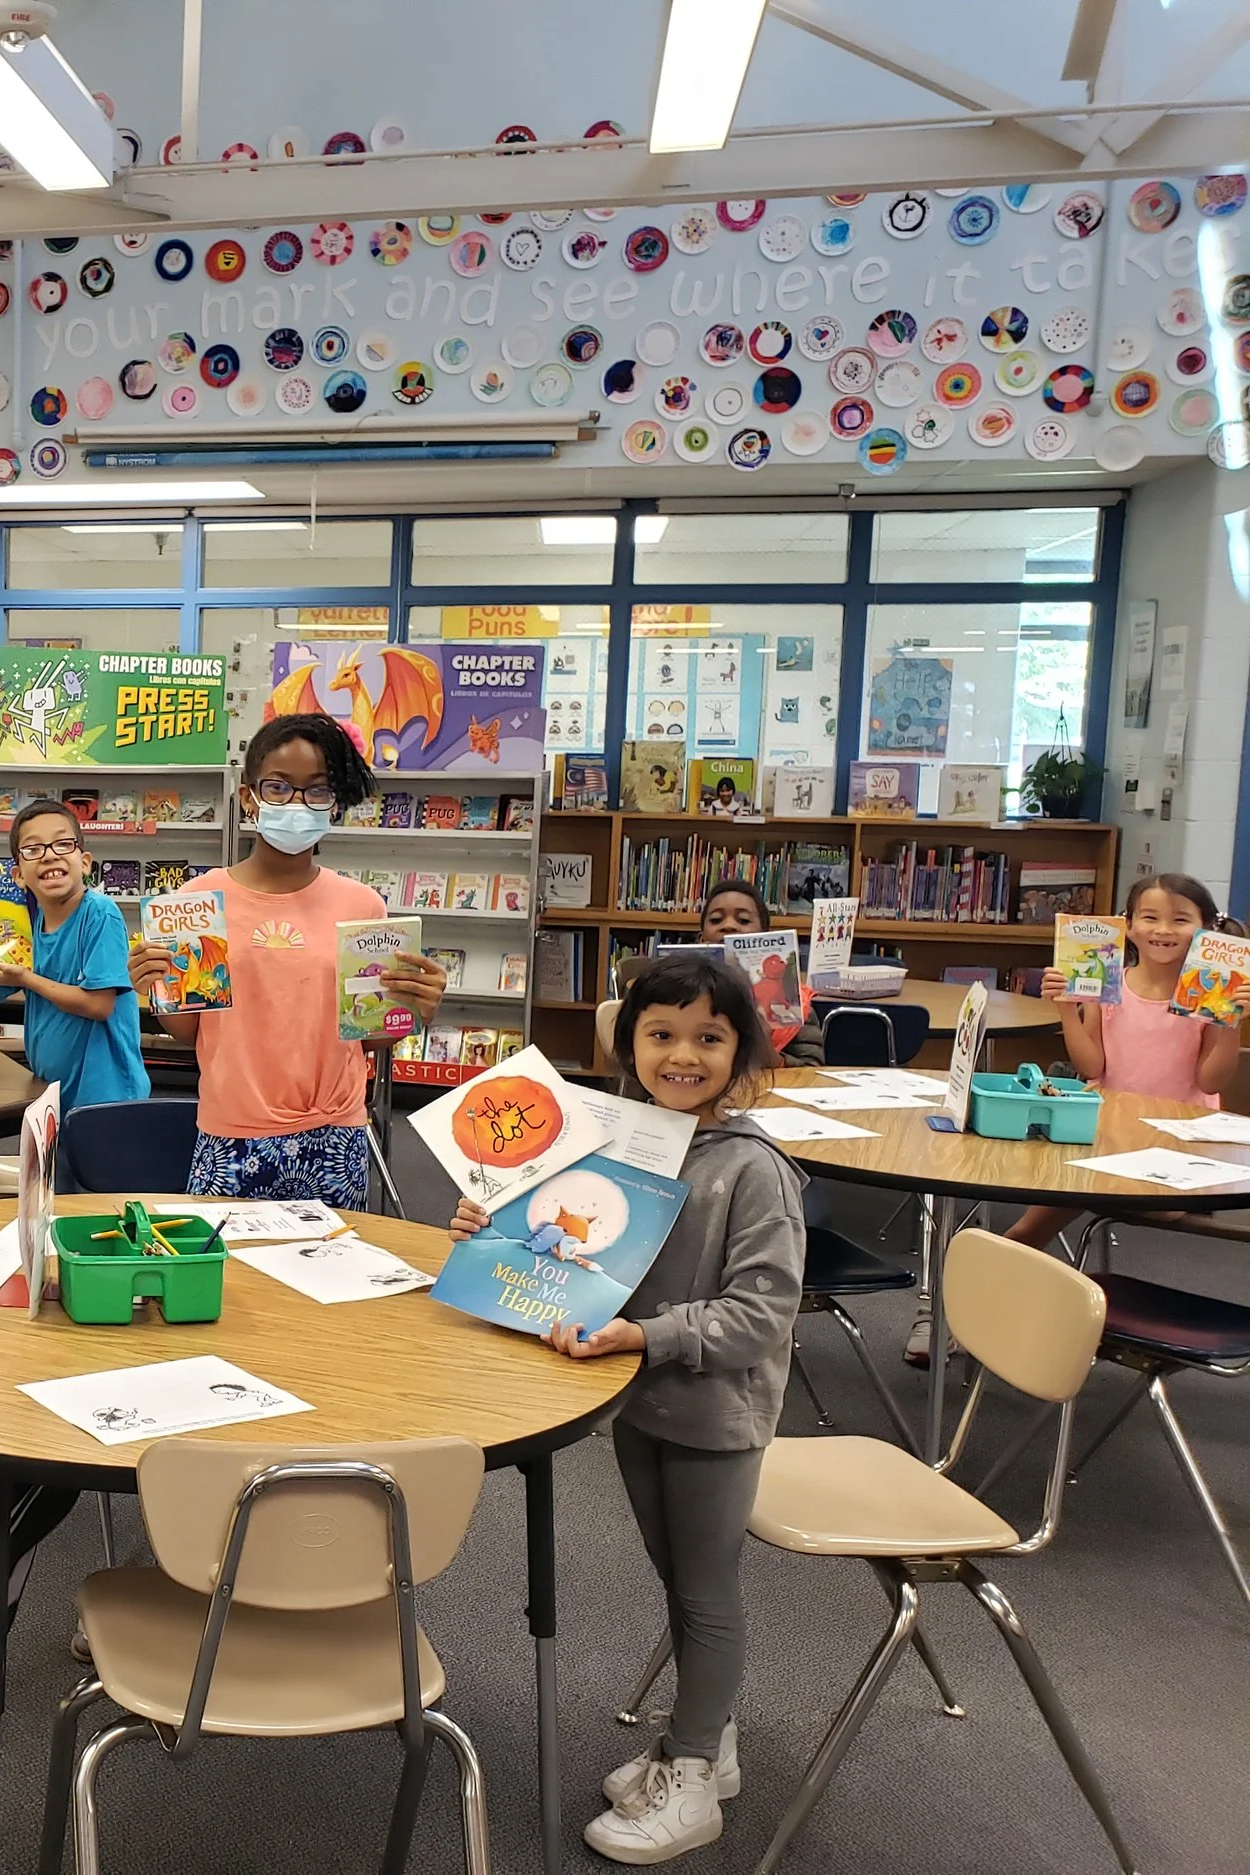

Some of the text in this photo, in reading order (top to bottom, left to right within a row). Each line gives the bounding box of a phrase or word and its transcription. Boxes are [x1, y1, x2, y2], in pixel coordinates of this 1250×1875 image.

[36, 303, 168, 371] your
[200, 276, 357, 338] mark
[384, 273, 501, 328] and
[531, 275, 639, 323] see
[671, 256, 891, 317] where
[923, 254, 982, 307] it
[468, 619, 527, 637] Puns
[99, 655, 223, 676] CHAPTER BOOKS
[452, 655, 535, 671] CHAPTER
[458, 671, 526, 687] BOOKS
[117, 686, 209, 716] PRESS
[115, 708, 215, 748] START!
[710, 761, 744, 773] China
[871, 774, 895, 790] SAY
[428, 806, 455, 818] PUG
[149, 899, 216, 919] DRAGON
[158, 914, 211, 934] GIRLS
[1072, 923, 1109, 936] Dolphin
[356, 933, 401, 950] Dolphin
[733, 936, 786, 949] Clifford
[1201, 948, 1245, 968] GIRLS
[477, 1096, 518, 1120] the
[493, 1104, 546, 1154] dot
[533, 1256, 570, 1285] You
[491, 1262, 568, 1305] Make Me
[496, 1285, 571, 1327] Happy
